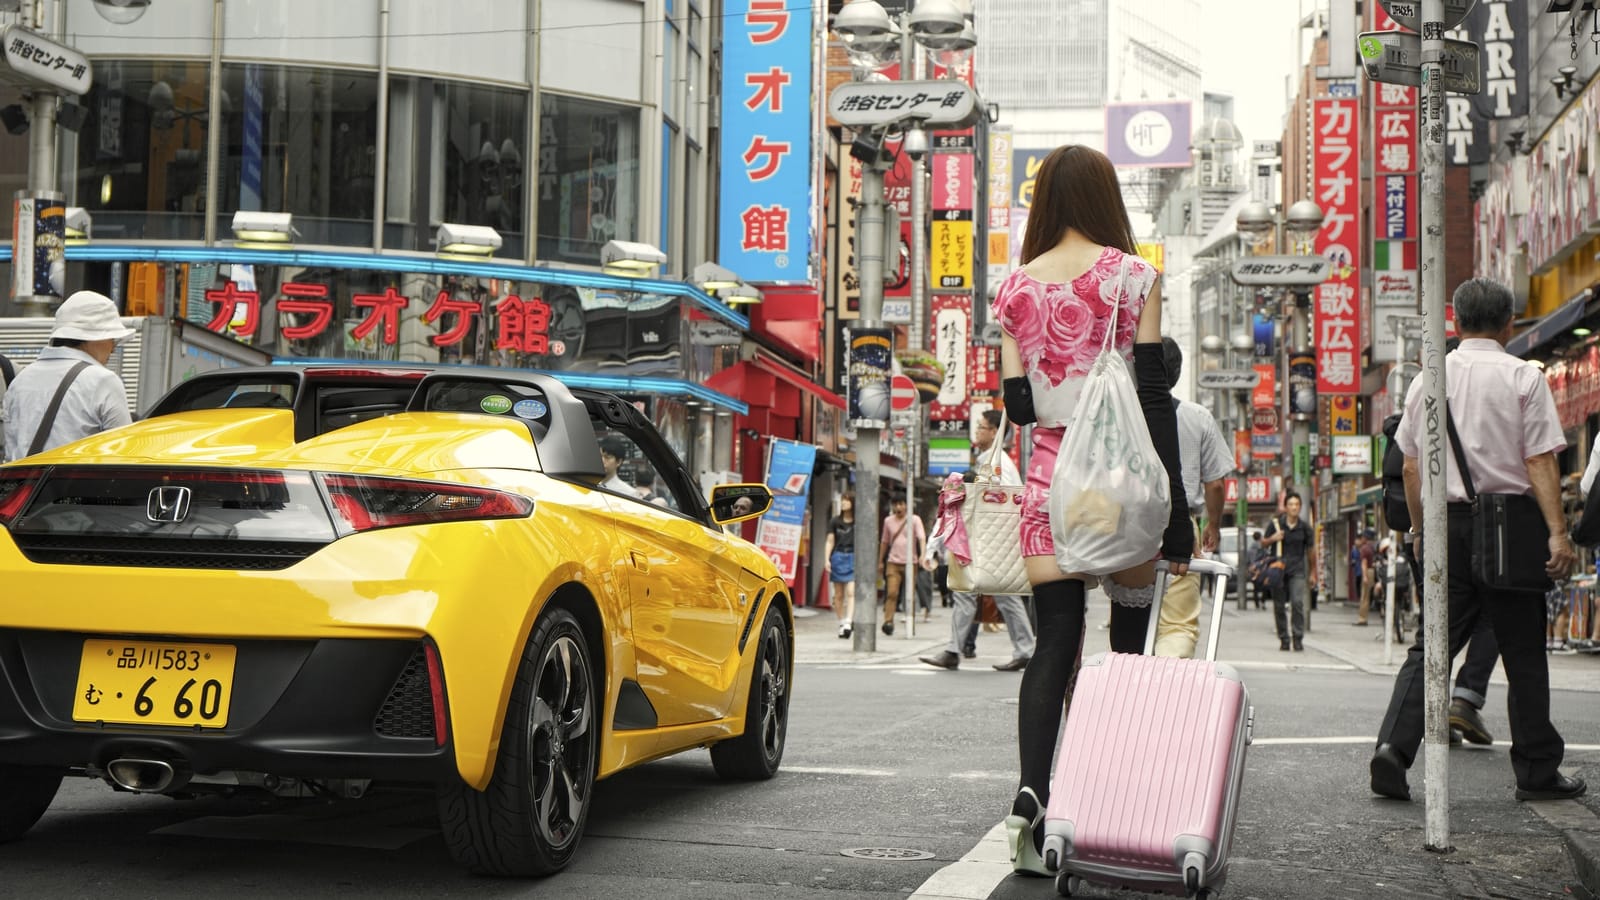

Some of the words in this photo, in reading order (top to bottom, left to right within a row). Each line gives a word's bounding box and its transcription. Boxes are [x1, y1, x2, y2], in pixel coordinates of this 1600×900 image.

[8, 37, 87, 80] 渋谷センター街
[1484, 0, 1517, 117] ART
[838, 91, 965, 111] 渋谷センター街
[1319, 101, 1354, 241] カラオケ
[945, 211, 960, 219] 4F
[205, 281, 552, 355] カラオケ館
[1319, 282, 1354, 386] 歌広場
[117, 648, 200, 671] 品川583
